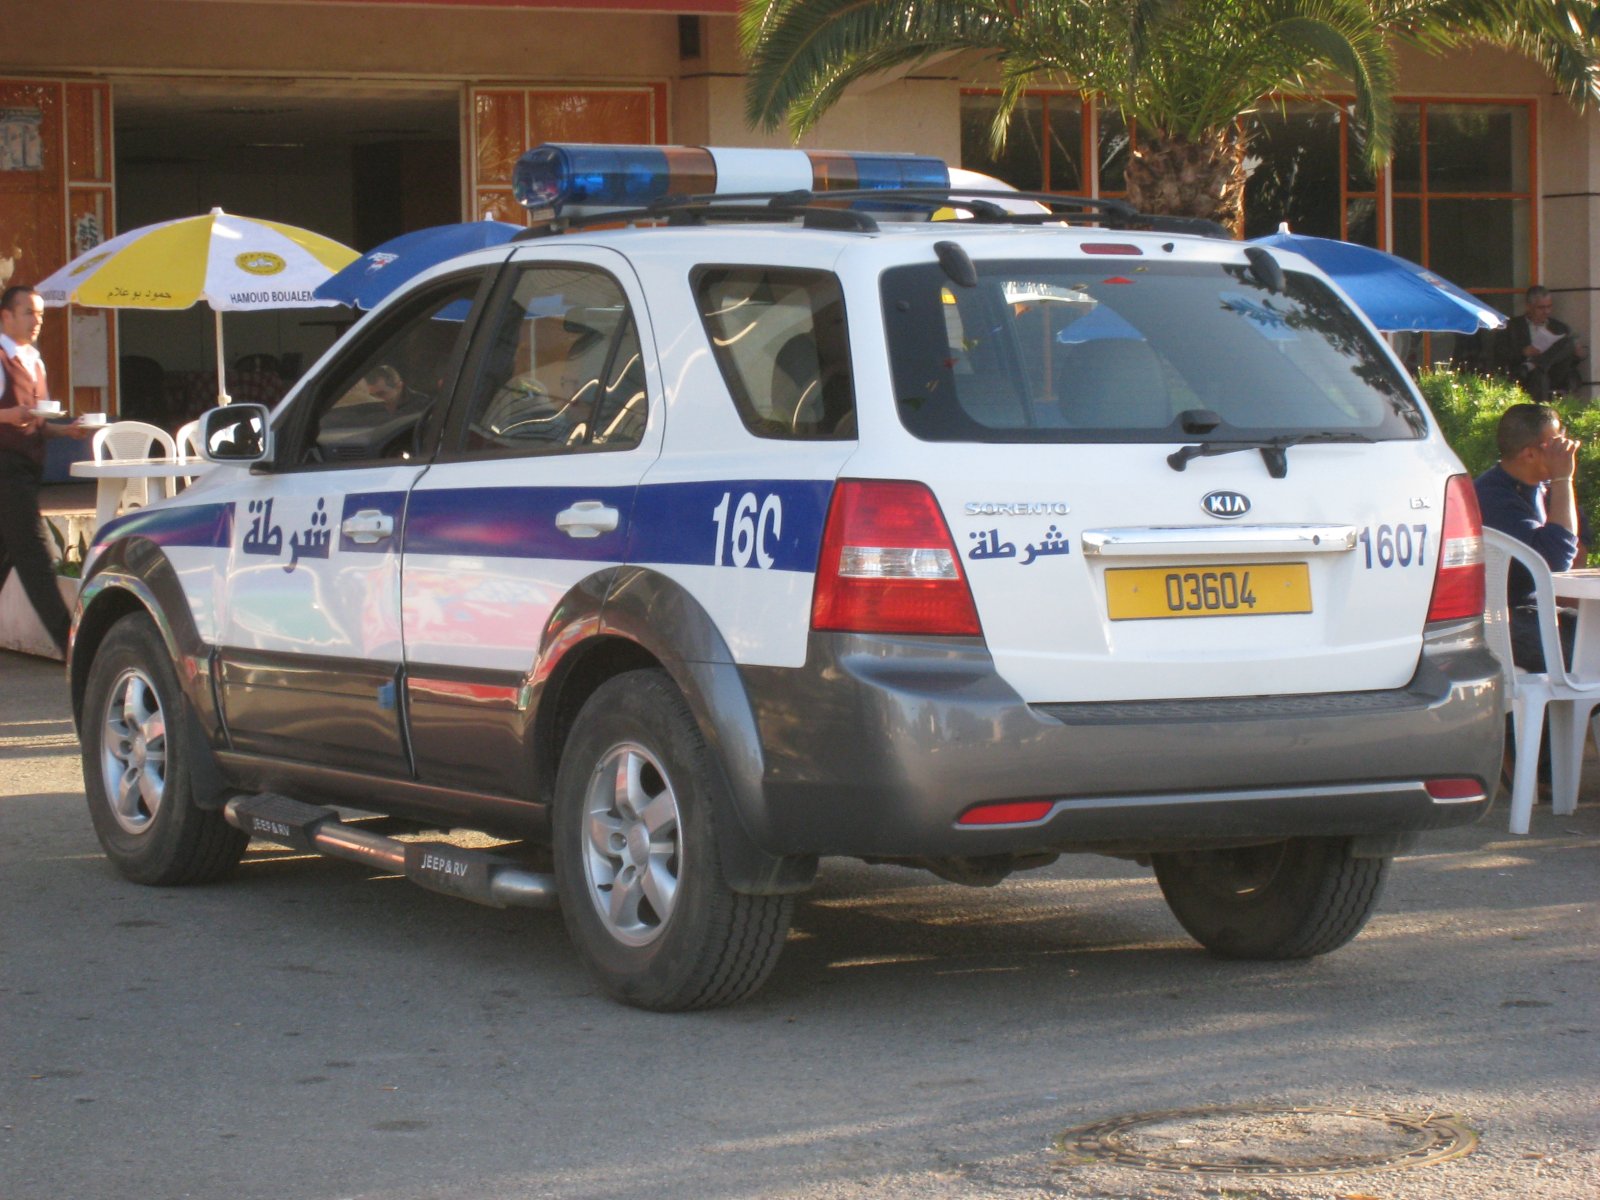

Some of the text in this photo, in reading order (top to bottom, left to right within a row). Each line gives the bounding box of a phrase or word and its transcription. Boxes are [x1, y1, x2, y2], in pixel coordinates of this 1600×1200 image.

[230, 291, 270, 304] HAMOUD
[964, 500, 1071, 517] SORENTO
[243, 497, 331, 574] شرطة
[968, 524, 1070, 566] شرطة
[1359, 522, 1427, 570] 1607
[1165, 571, 1257, 611] 03604
